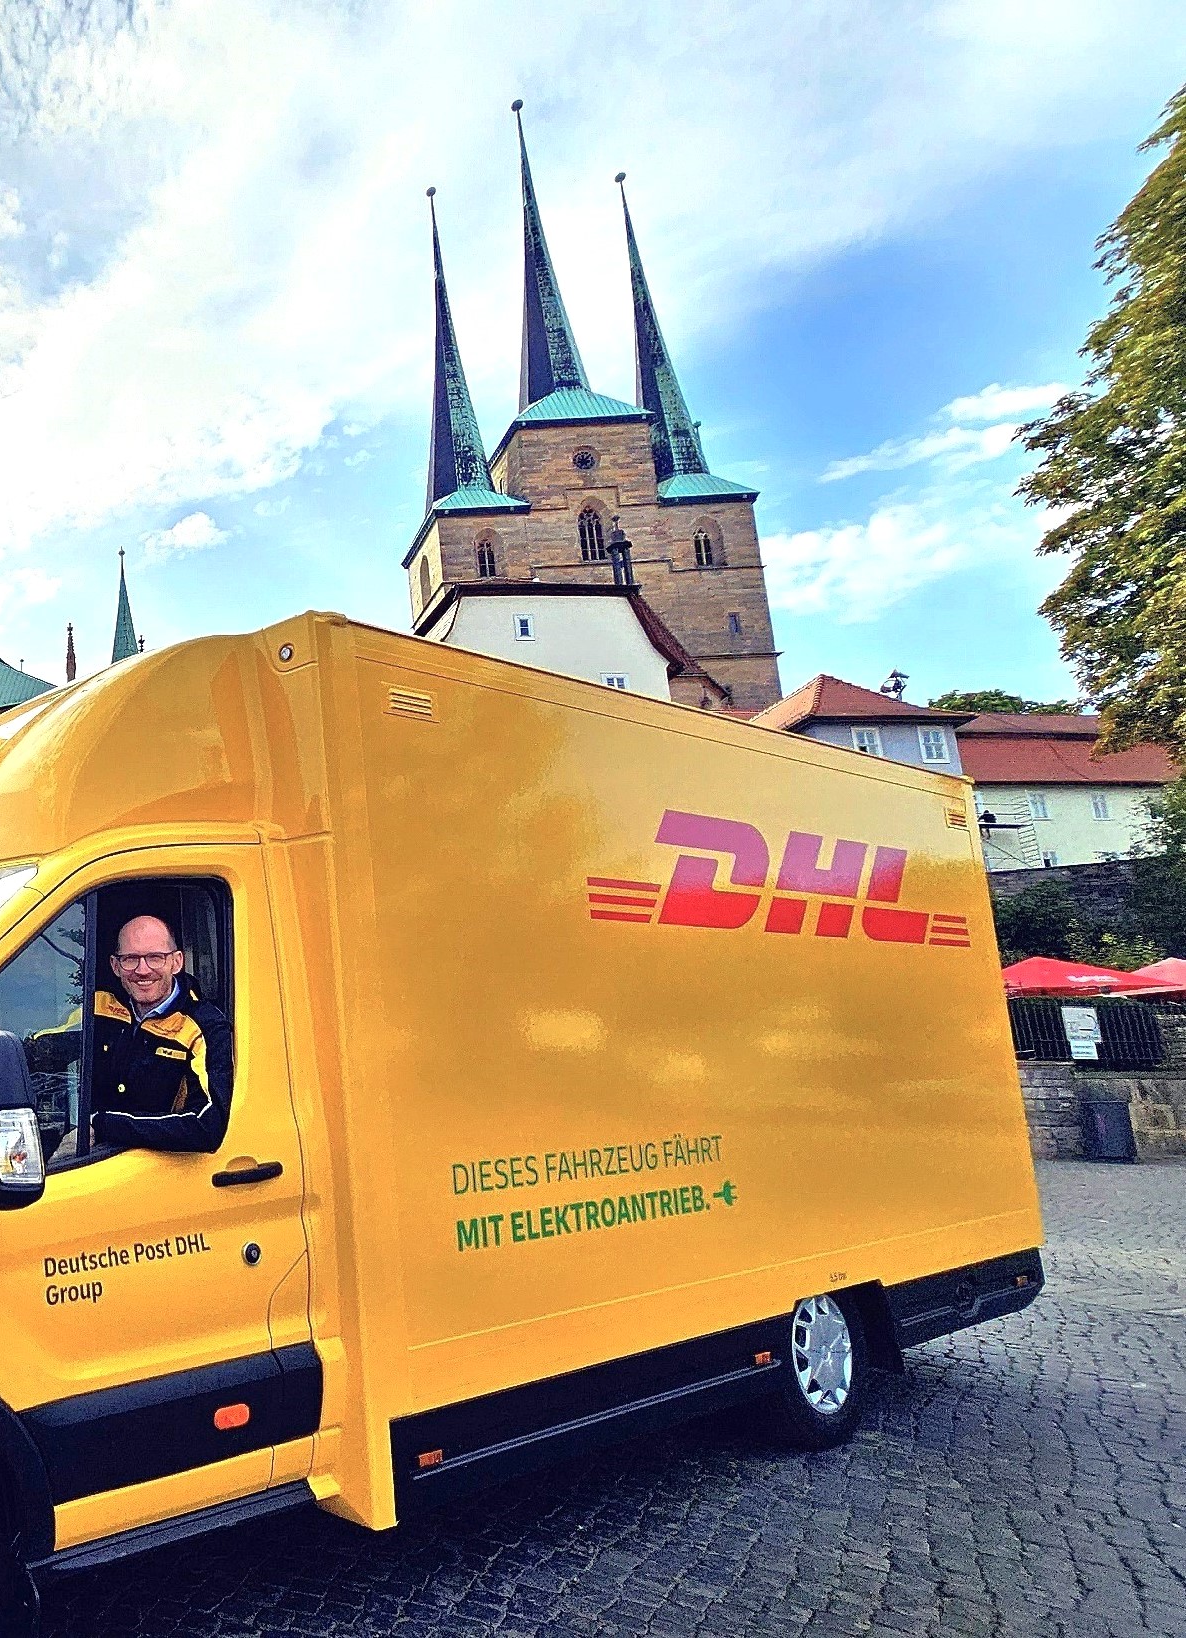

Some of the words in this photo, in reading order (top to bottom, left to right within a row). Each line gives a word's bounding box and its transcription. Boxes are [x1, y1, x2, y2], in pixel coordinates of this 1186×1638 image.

[654, 809, 929, 944] DHL
[452, 1155, 539, 1195] DIESES
[545, 1142, 659, 1183] FAHRZEUG
[662, 1134, 722, 1168] FÄHRT
[456, 1214, 504, 1252] MIT
[510, 1184, 711, 1242] ELEKTROANTRIEB.
[43, 1246, 130, 1278] Deutsche
[133, 1238, 173, 1263] Post
[175, 1232, 211, 1256] DHL
[45, 1281, 104, 1306] Group
